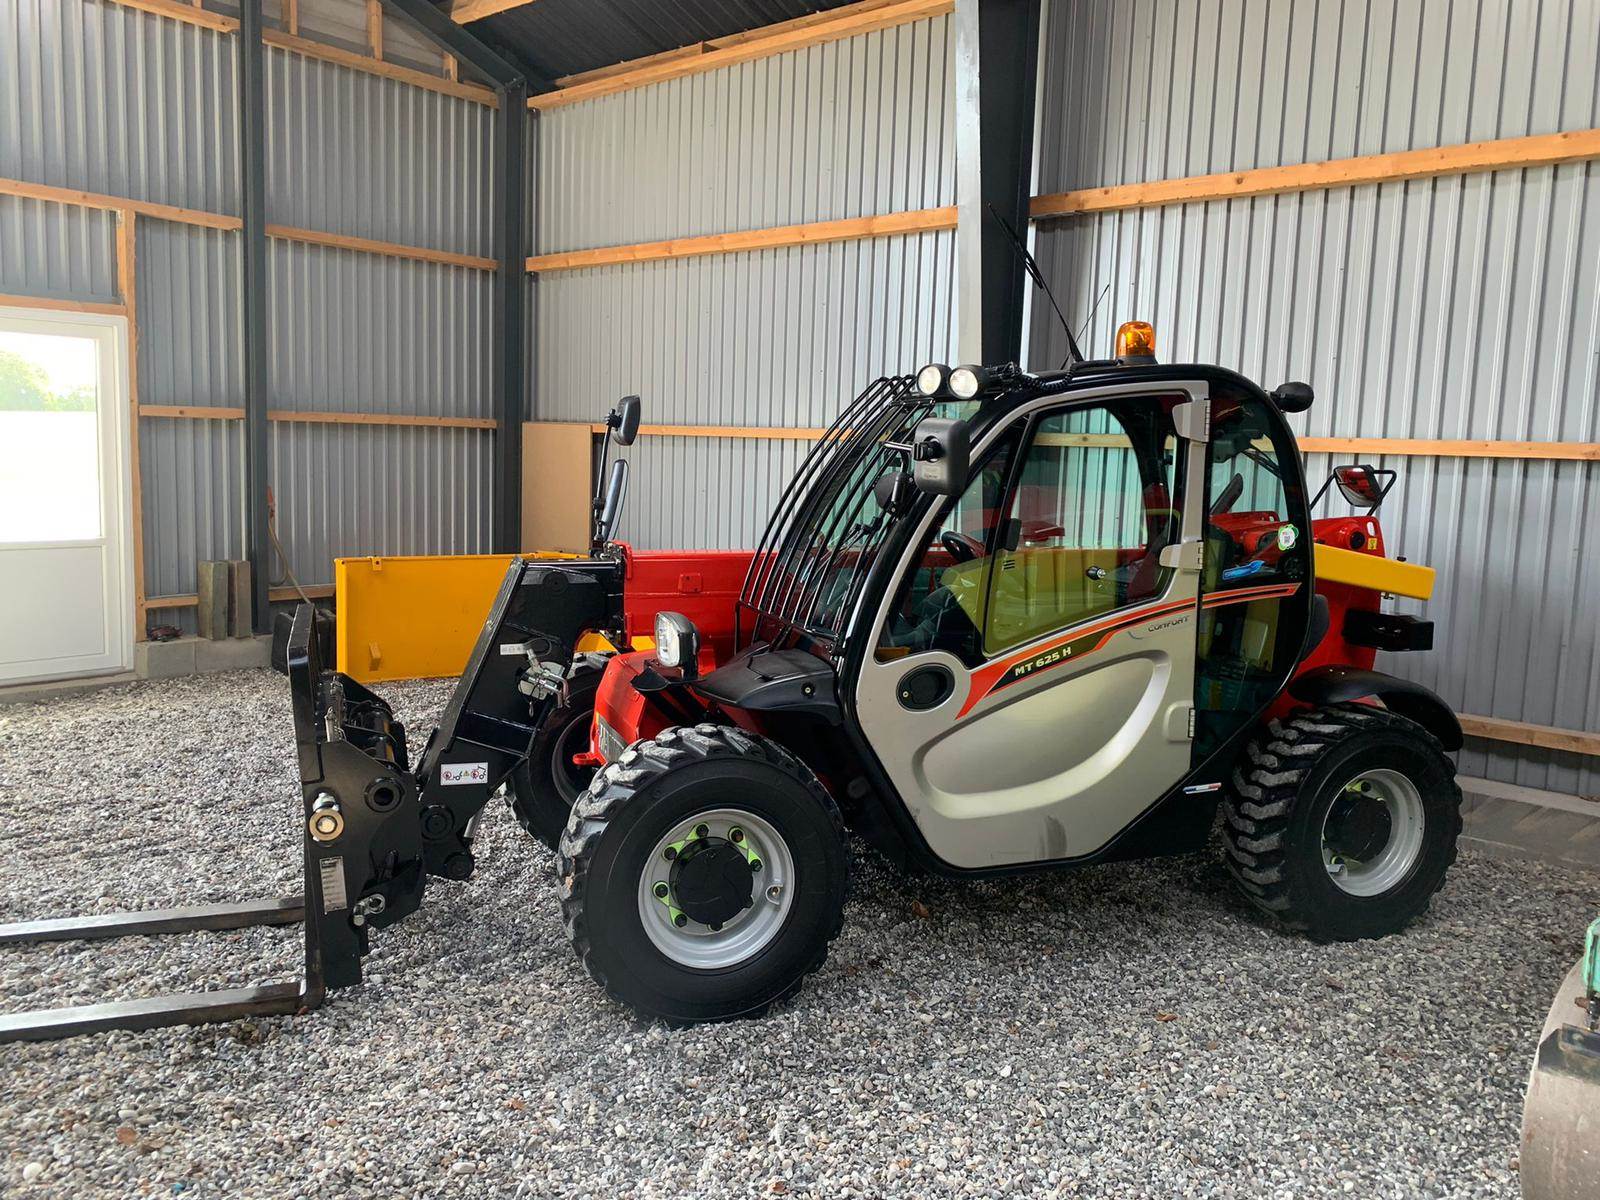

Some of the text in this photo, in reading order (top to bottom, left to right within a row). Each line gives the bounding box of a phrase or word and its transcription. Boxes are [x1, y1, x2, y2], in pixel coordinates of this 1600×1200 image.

[1014, 646, 1072, 676] MT 625 H
